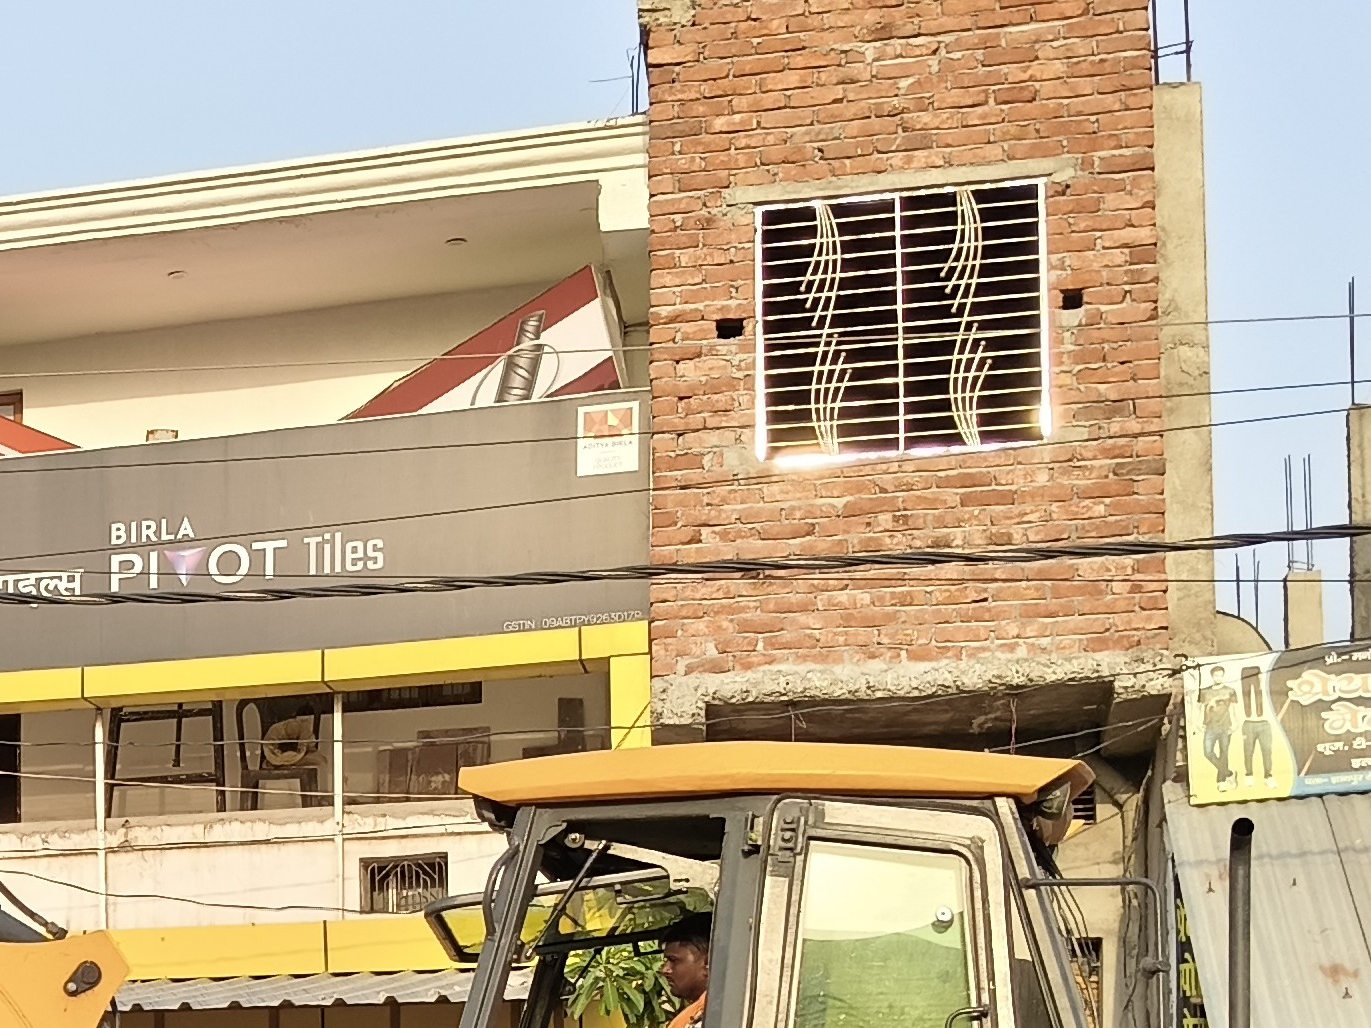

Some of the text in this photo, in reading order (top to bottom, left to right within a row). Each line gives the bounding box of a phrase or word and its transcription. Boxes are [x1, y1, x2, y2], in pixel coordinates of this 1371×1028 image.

[110, 516, 195, 545] BIRLA
[109, 538, 288, 593] PIVOT
[303, 531, 385, 576] Tiles
